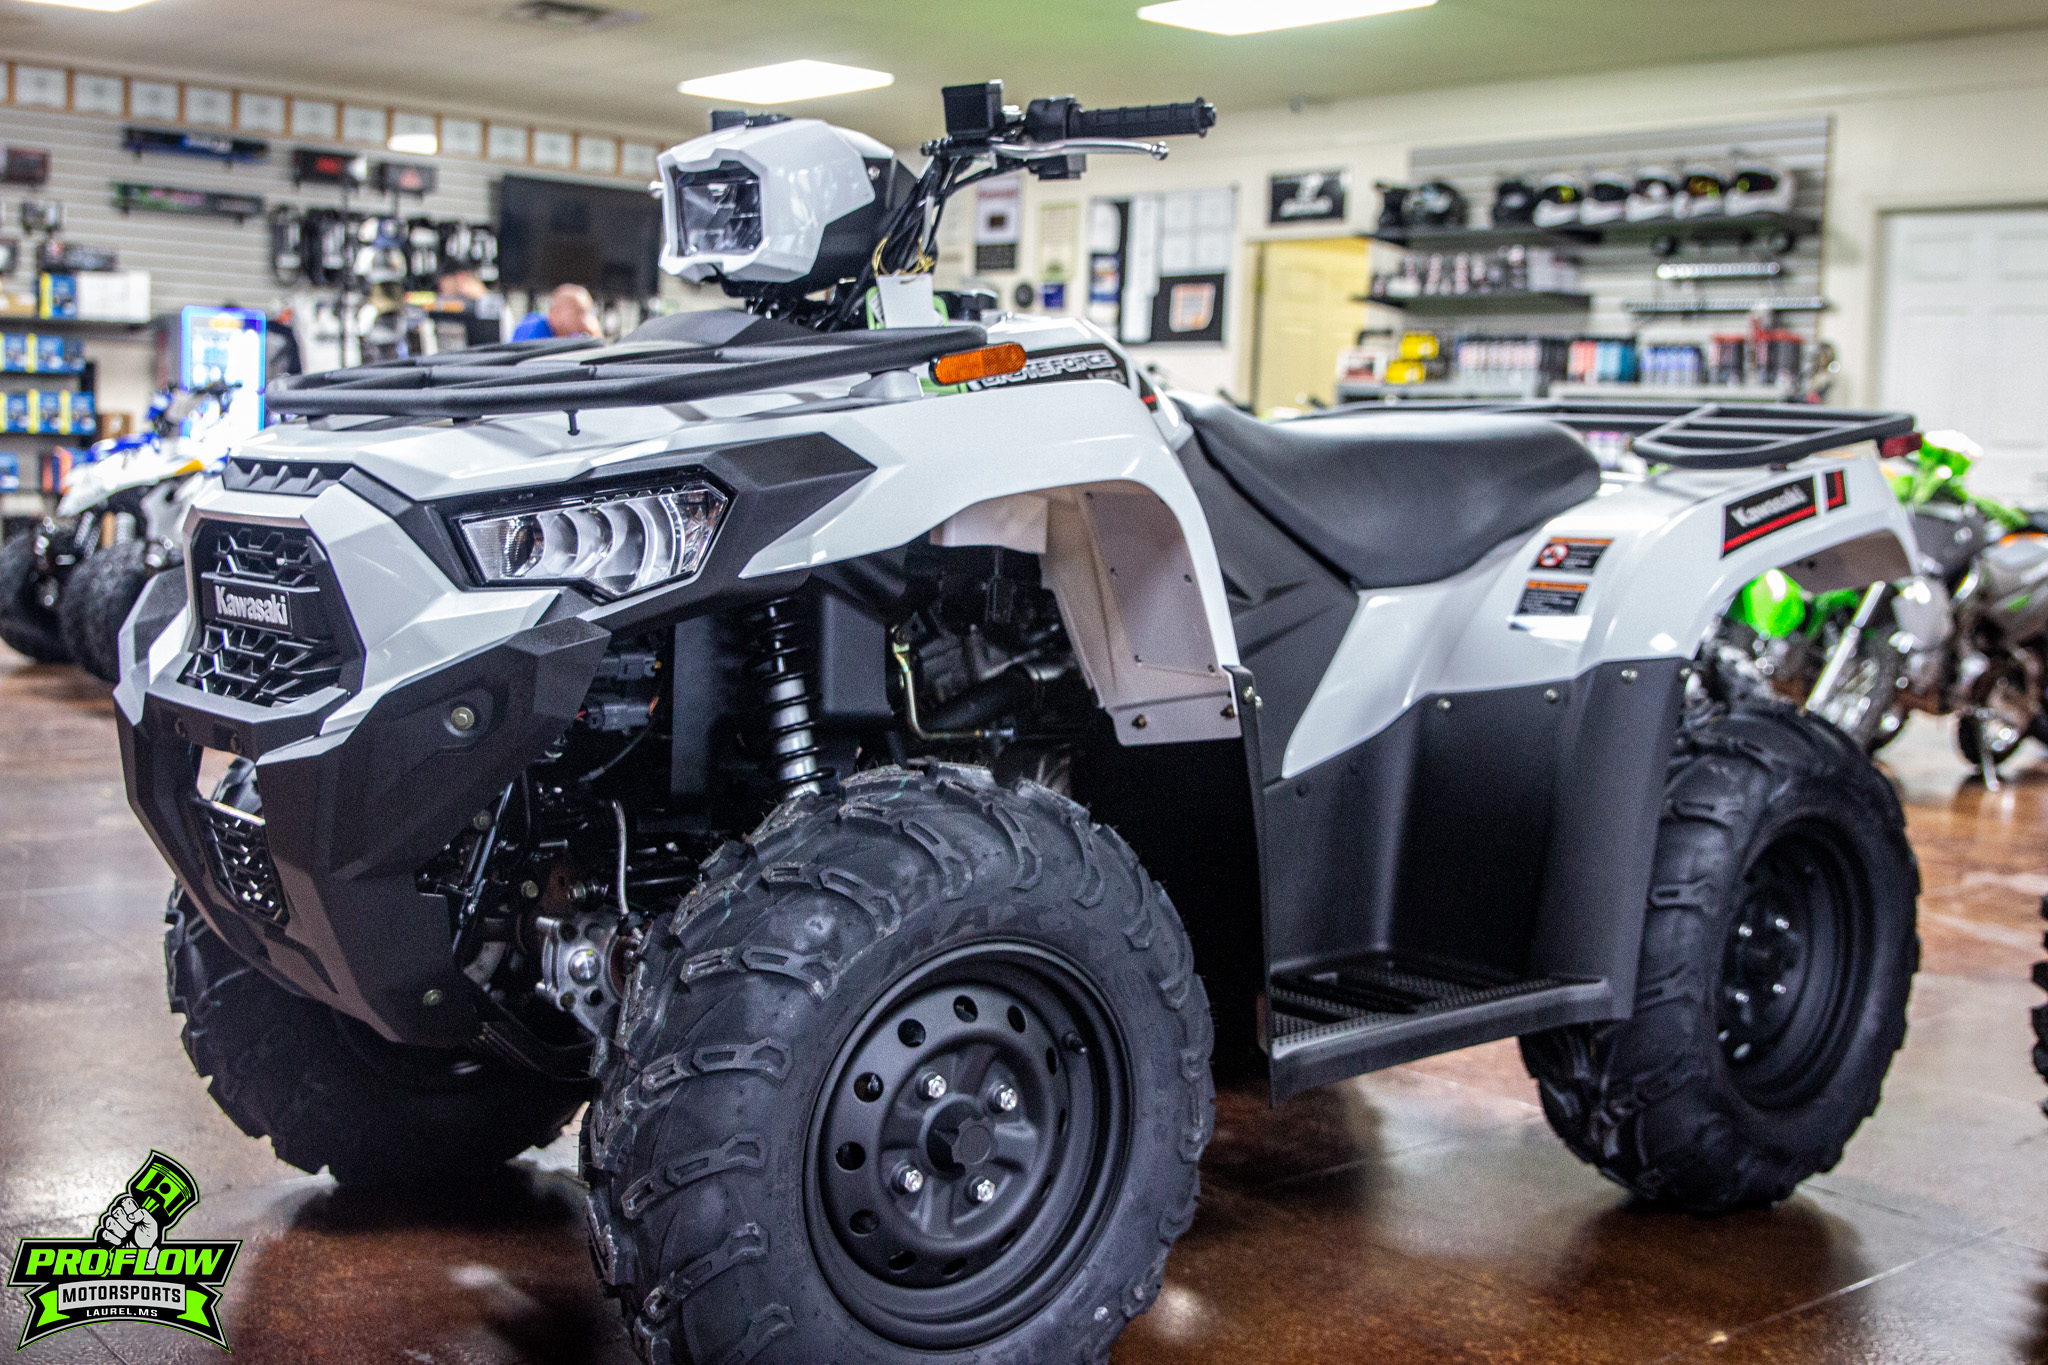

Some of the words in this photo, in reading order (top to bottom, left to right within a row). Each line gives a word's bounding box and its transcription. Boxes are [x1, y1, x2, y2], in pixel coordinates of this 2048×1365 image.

[1049, 349, 1117, 375] FORCE
[1730, 483, 1808, 527] Kawasaki
[214, 585, 288, 626] Kawasaki
